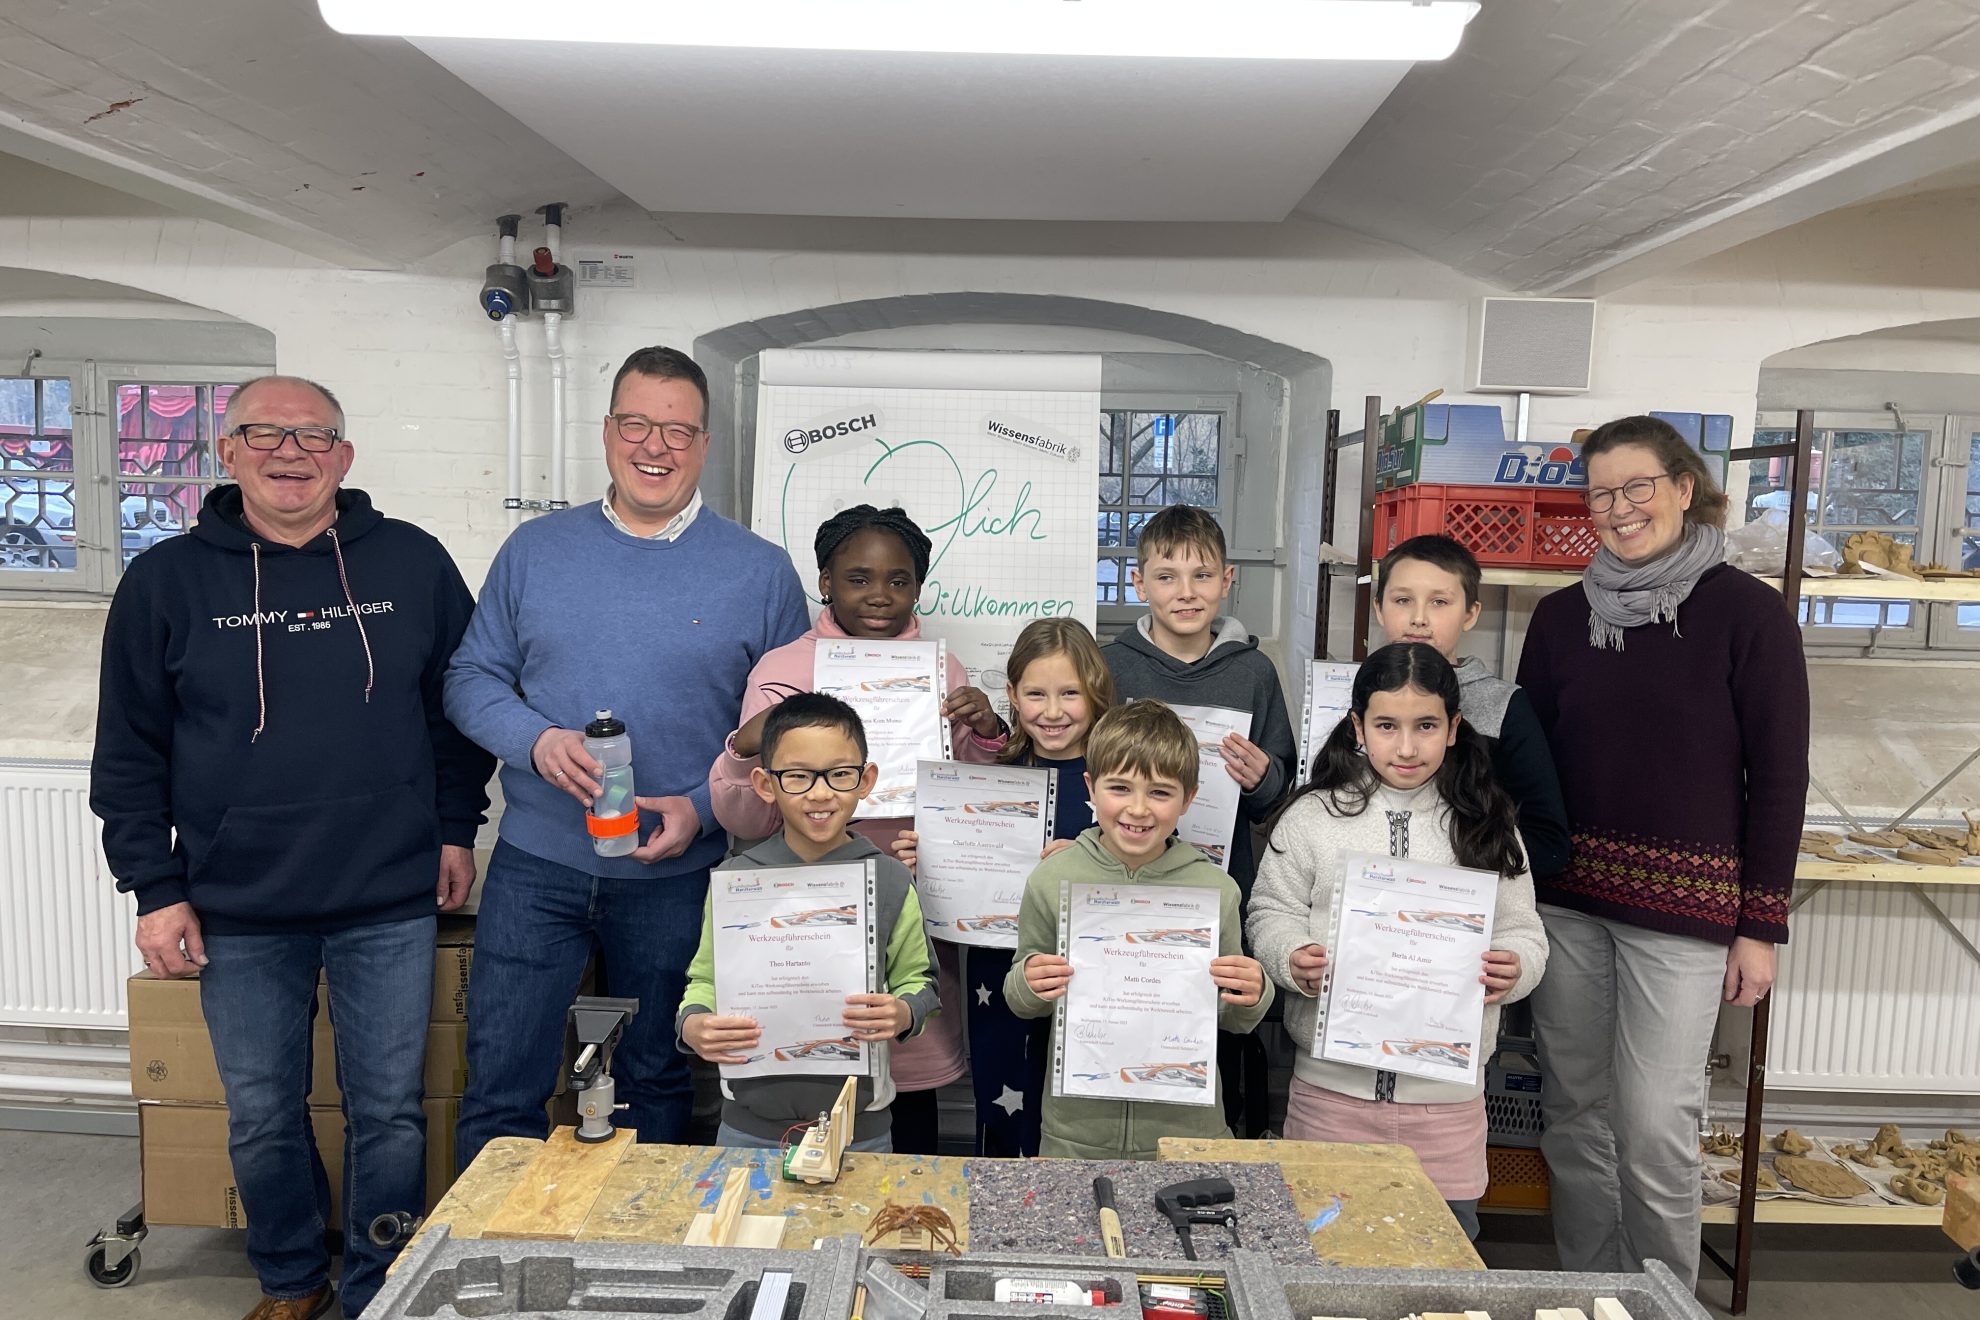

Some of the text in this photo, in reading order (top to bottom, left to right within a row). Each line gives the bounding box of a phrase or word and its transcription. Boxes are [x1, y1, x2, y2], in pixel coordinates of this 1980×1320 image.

[808, 413, 877, 444] BOSCH
[988, 420, 1067, 455] Wissensfabrik
[212, 601, 395, 629] TOMMY HILFIGER
[311, 621, 331, 631] 1985
[749, 932, 831, 944] Werkzeugführerschein
[1103, 947, 1185, 960] Werkzeugführerschein
